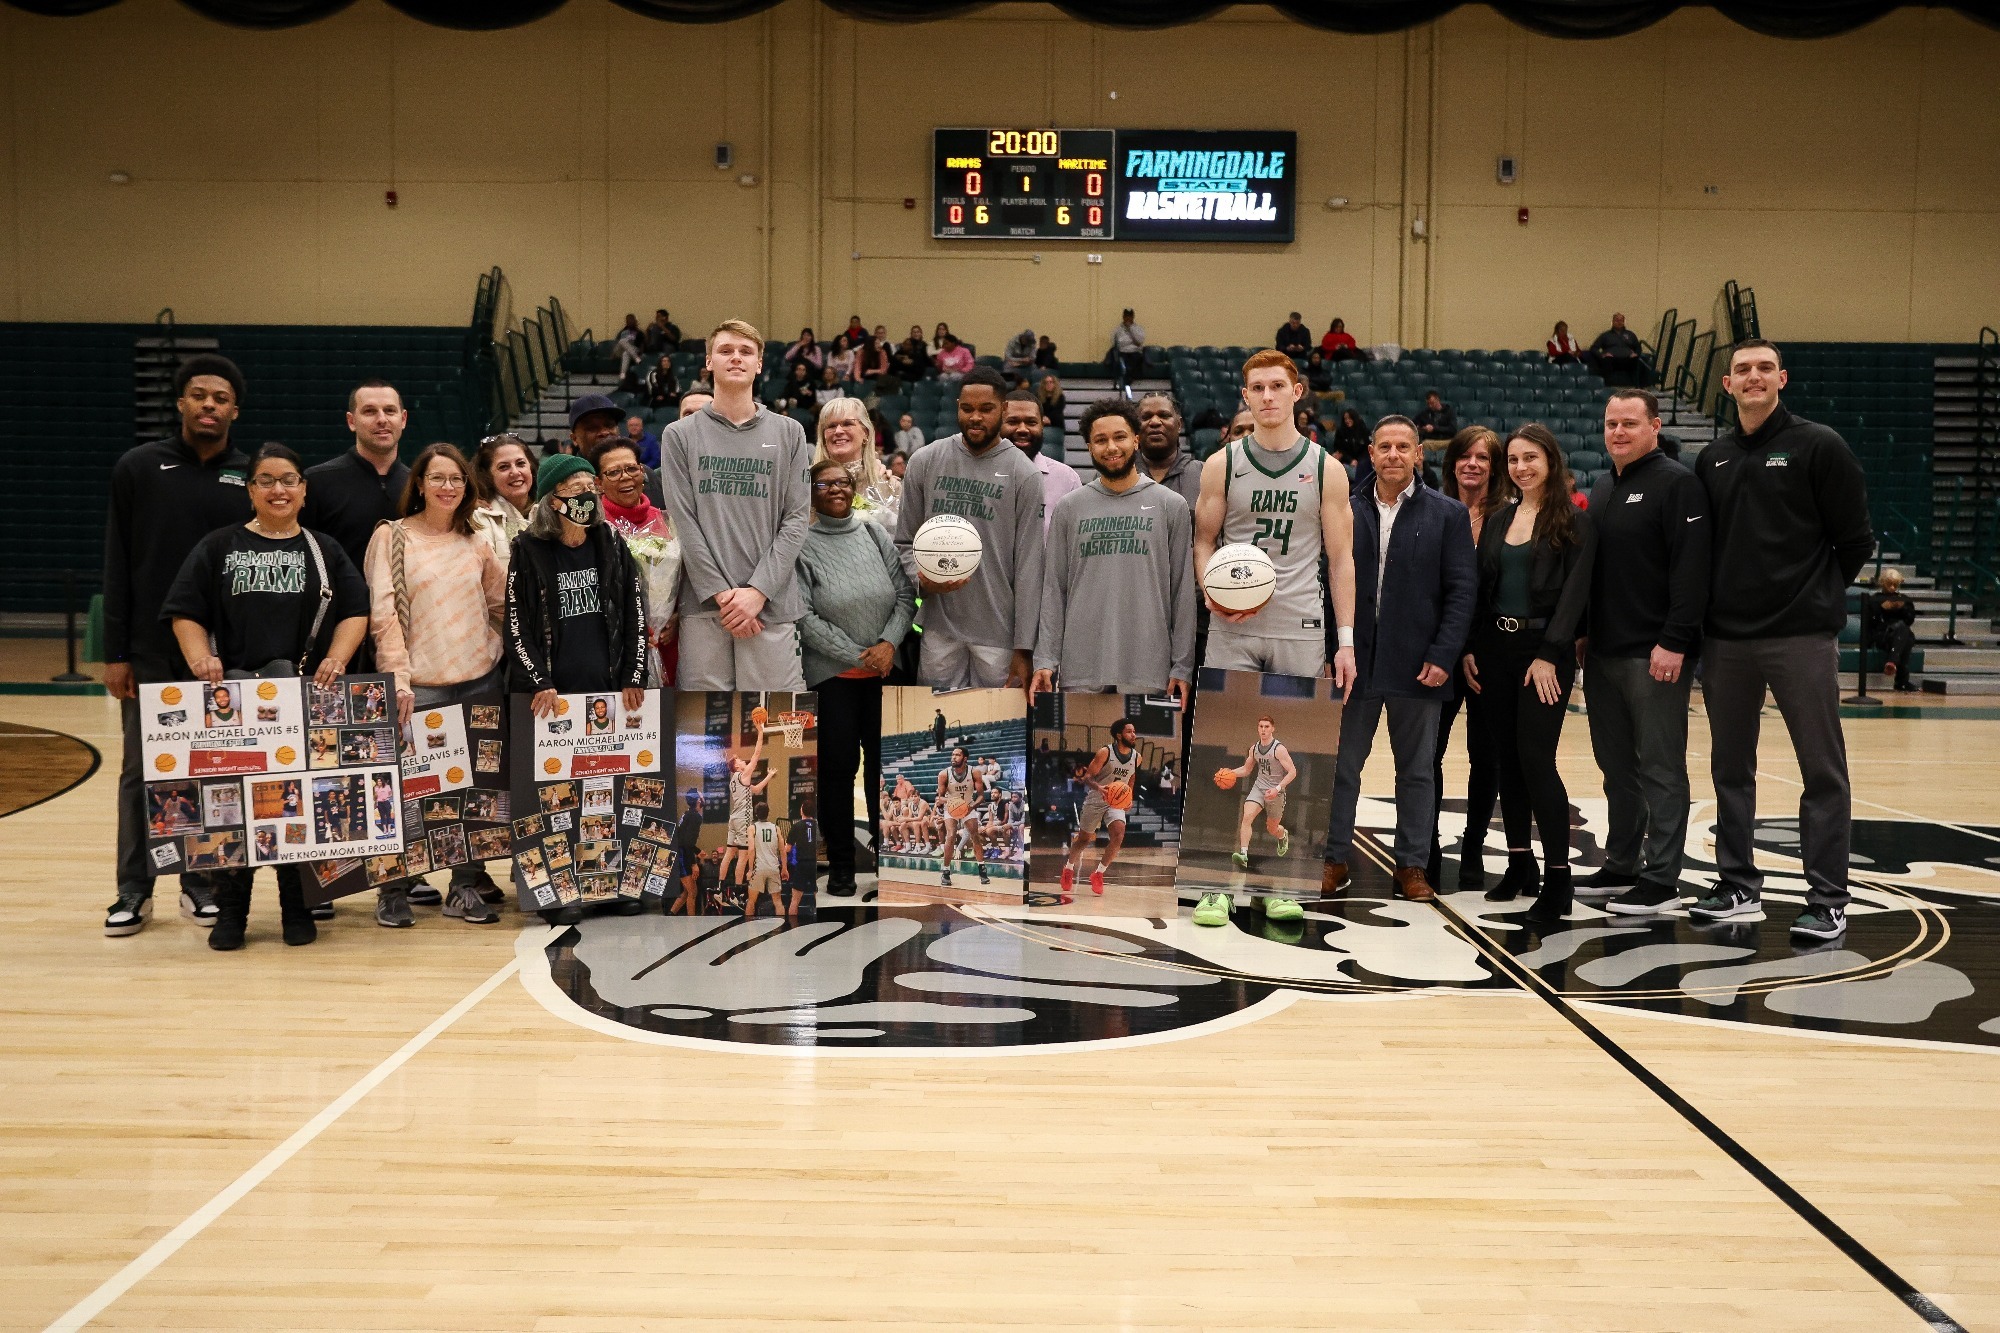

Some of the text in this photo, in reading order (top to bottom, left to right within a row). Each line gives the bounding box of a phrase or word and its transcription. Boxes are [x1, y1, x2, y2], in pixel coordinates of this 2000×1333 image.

[990, 131, 1057, 154] 20:00
[946, 157, 982, 168] RAMS
[1011, 165, 1037, 173] PERIOD
[1058, 158, 1107, 170] MARITIME
[1125, 150, 1286, 179] FARMINGDALE
[966, 172, 981, 195] 0
[1023, 175, 1030, 192] 1
[1087, 173, 1102, 196] 0
[1163, 181, 1244, 190] STATE
[942, 197, 966, 205] FOULS
[1000, 198, 1028, 206] PLAYER
[1081, 198, 1105, 206] FOULS
[1126, 191, 1277, 221] BASKETBALL
[950, 205, 962, 224] 0
[975, 205, 989, 224] 6
[1057, 206, 1070, 225] 6
[1089, 206, 1102, 225] 0
[942, 227, 966, 235] SCORE
[1010, 227, 1036, 235] MATCH
[1081, 228, 1104, 236] SCORE
[698, 455, 774, 476] FARMINGDALE
[698, 479, 769, 498] BASKETBALL
[933, 475, 1005, 499] FARMINGDALE
[932, 498, 995, 521] BASKETBALL
[1251, 490, 1299, 513] RAMS
[1078, 515, 1154, 535] FARMINGDALE
[1251, 518, 1294, 556] 24
[1079, 539, 1149, 558] BASKETBALL
[509, 606, 521, 637] MICKEY
[146, 725, 300, 743] AARON MICHAEL DAVIS #5
[538, 731, 657, 748] AARON MICHAEL DAVIS #5
[421, 750, 451, 764] DAVIS
[453, 747, 465, 756] #5
[761, 828, 773, 843] 10
[280, 843, 400, 861] WE KNOW MOM IS PROUD
